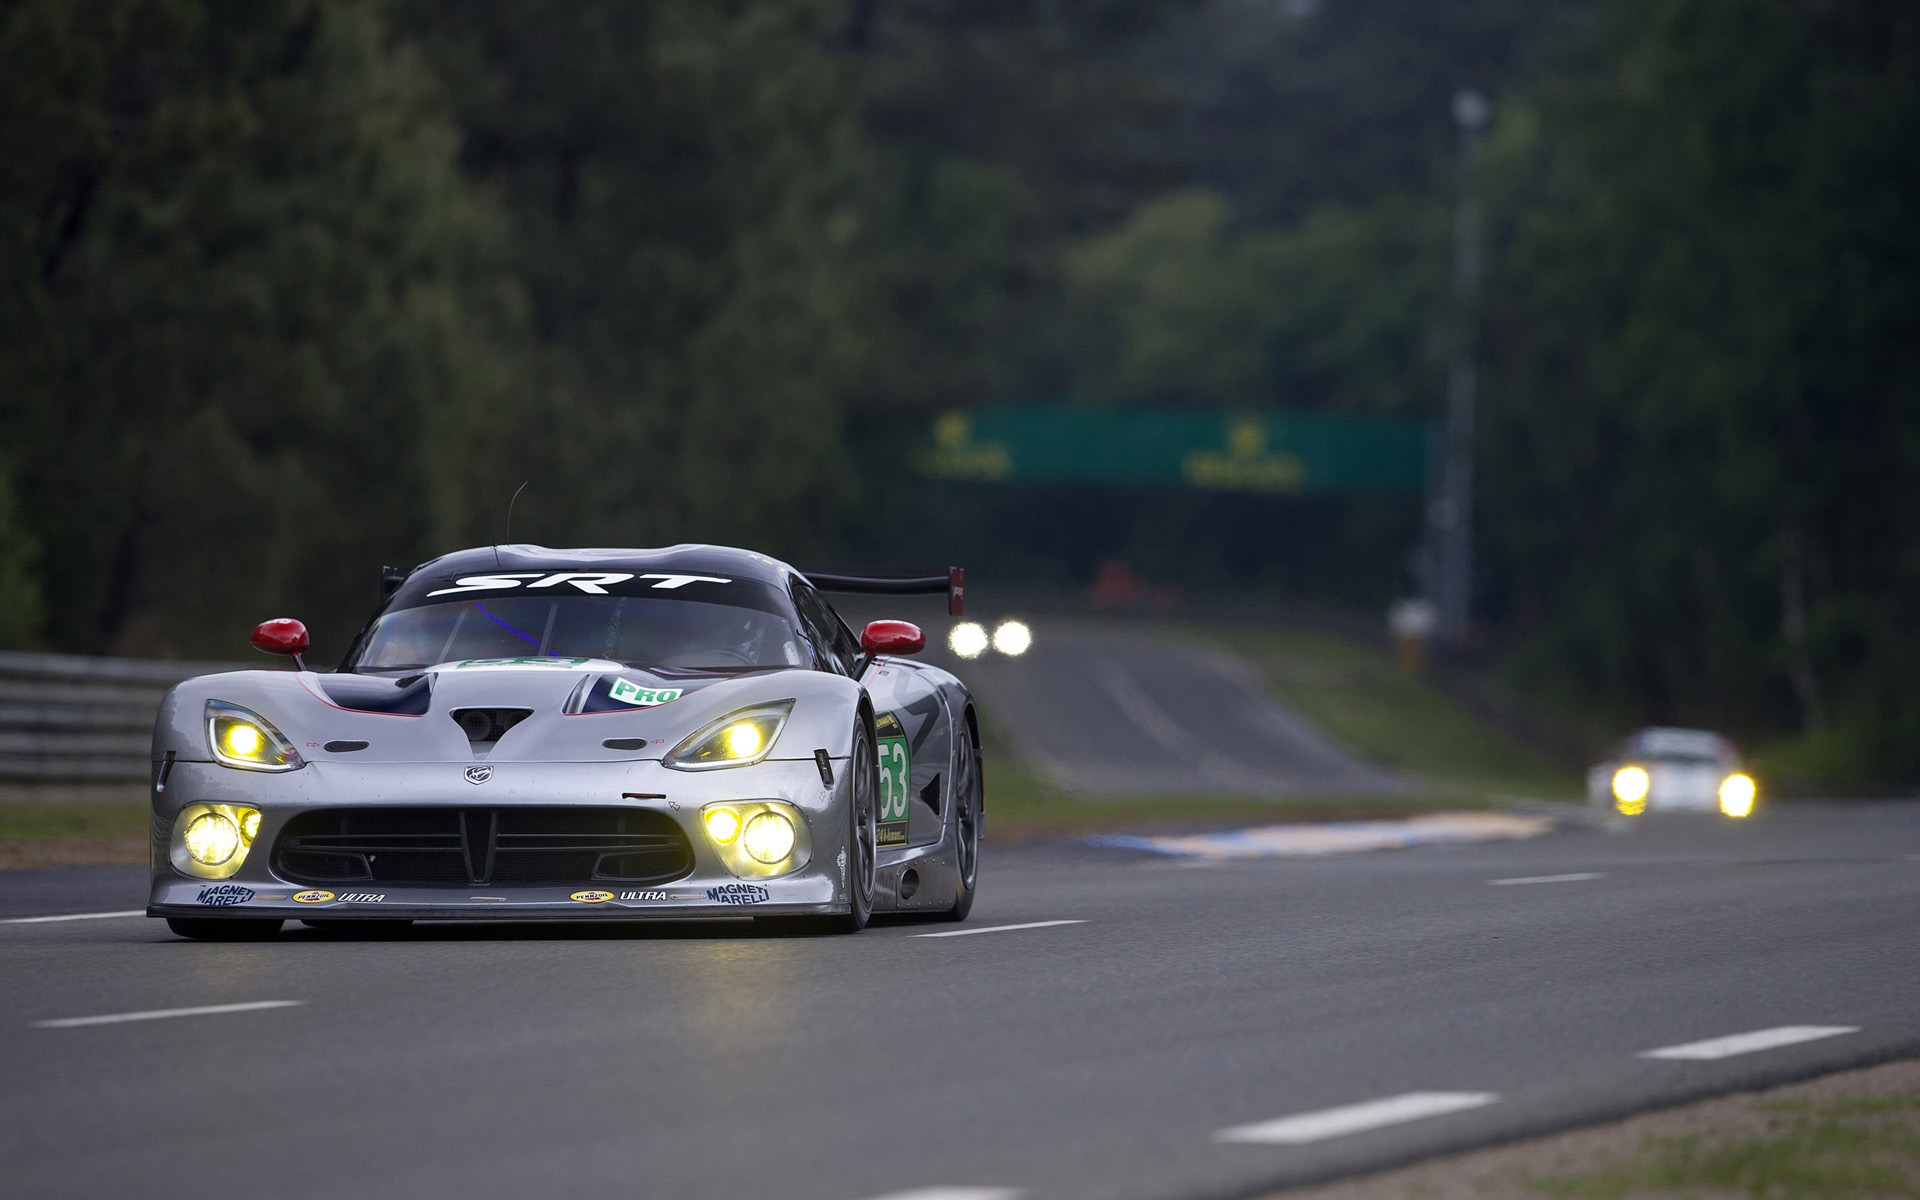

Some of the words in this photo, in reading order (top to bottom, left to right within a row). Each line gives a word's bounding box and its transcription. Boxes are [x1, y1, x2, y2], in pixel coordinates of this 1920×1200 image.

[426, 572, 732, 597] SRT
[614, 680, 678, 703] PRO
[878, 742, 907, 820] 53
[196, 885, 256, 900] MAGNETI
[196, 891, 256, 906] MARELLI
[337, 892, 386, 903] ULTRA
[620, 891, 667, 901] ULTRA
[706, 884, 770, 899] MAGNETI
[706, 890, 770, 905] MARELLI
